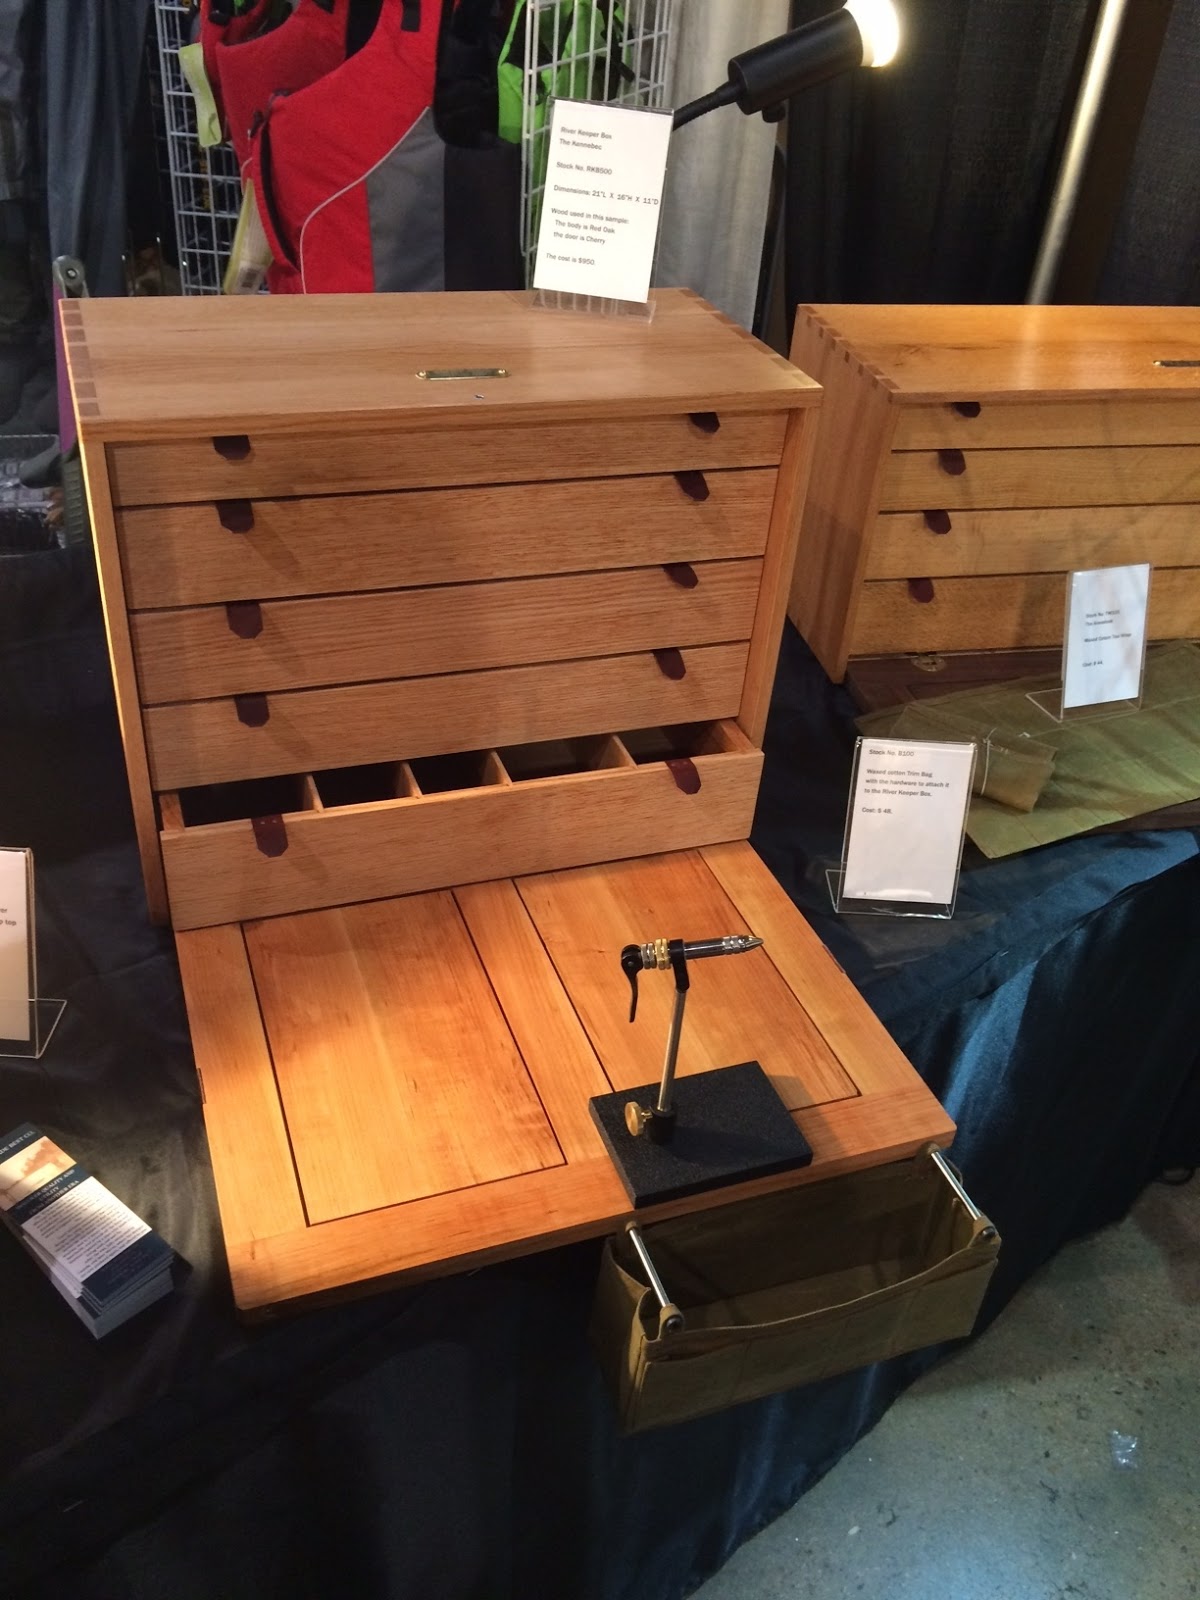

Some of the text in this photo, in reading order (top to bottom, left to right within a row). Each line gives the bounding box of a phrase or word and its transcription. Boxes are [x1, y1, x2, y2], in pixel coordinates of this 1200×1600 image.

[578, 130, 599, 138] Keeper
[572, 140, 602, 150] Kennebec
[586, 166, 612, 175] RKB500
[554, 185, 590, 196] Dimensions:
[605, 216, 629, 224] sample:
[568, 222, 581, 230] body
[586, 236, 605, 245] Cherry
